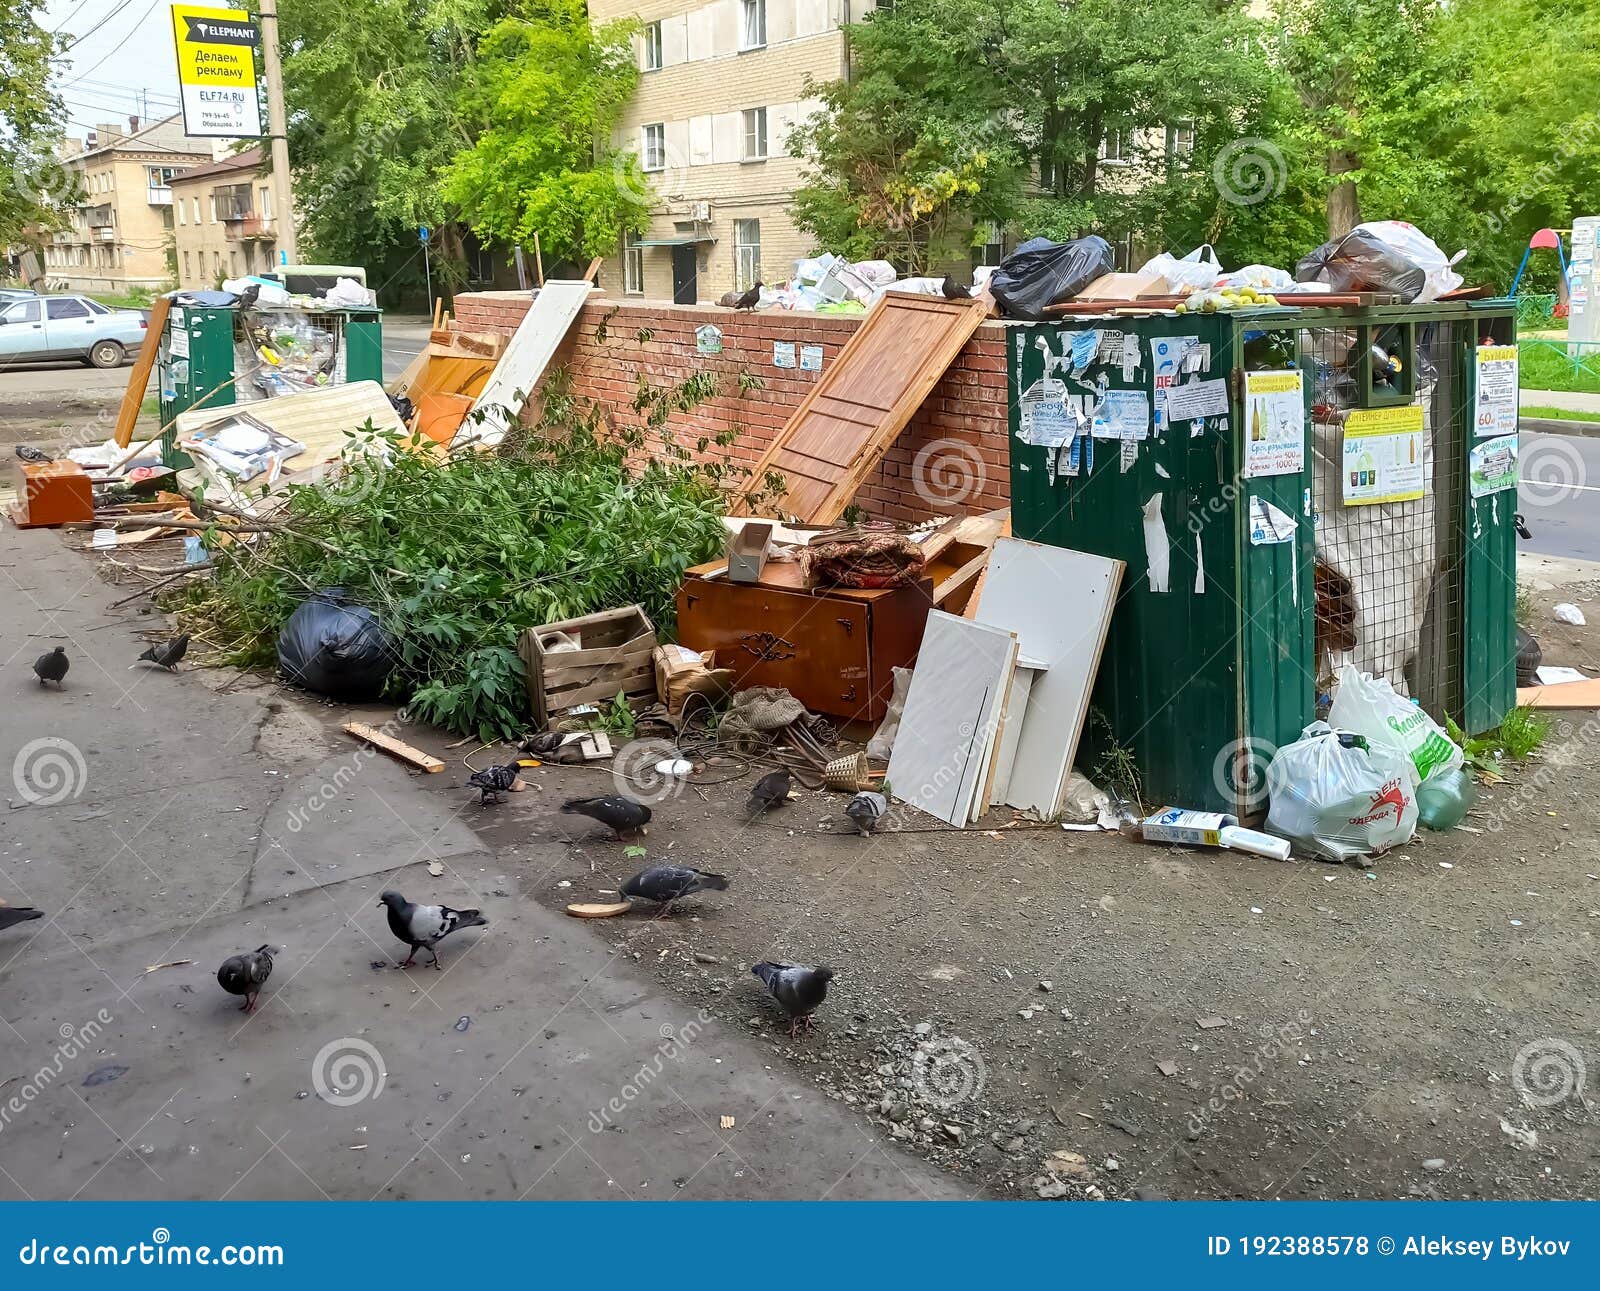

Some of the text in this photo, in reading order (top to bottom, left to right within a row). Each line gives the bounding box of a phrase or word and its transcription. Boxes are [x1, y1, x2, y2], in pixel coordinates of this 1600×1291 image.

[209, 25, 255, 39] ELEPHANT
[195, 50, 238, 63] Делаем
[196, 66, 243, 79] рекламу
[199, 91, 245, 102] ELF74.RU
[1034, 402, 1064, 410] СРОЧ
